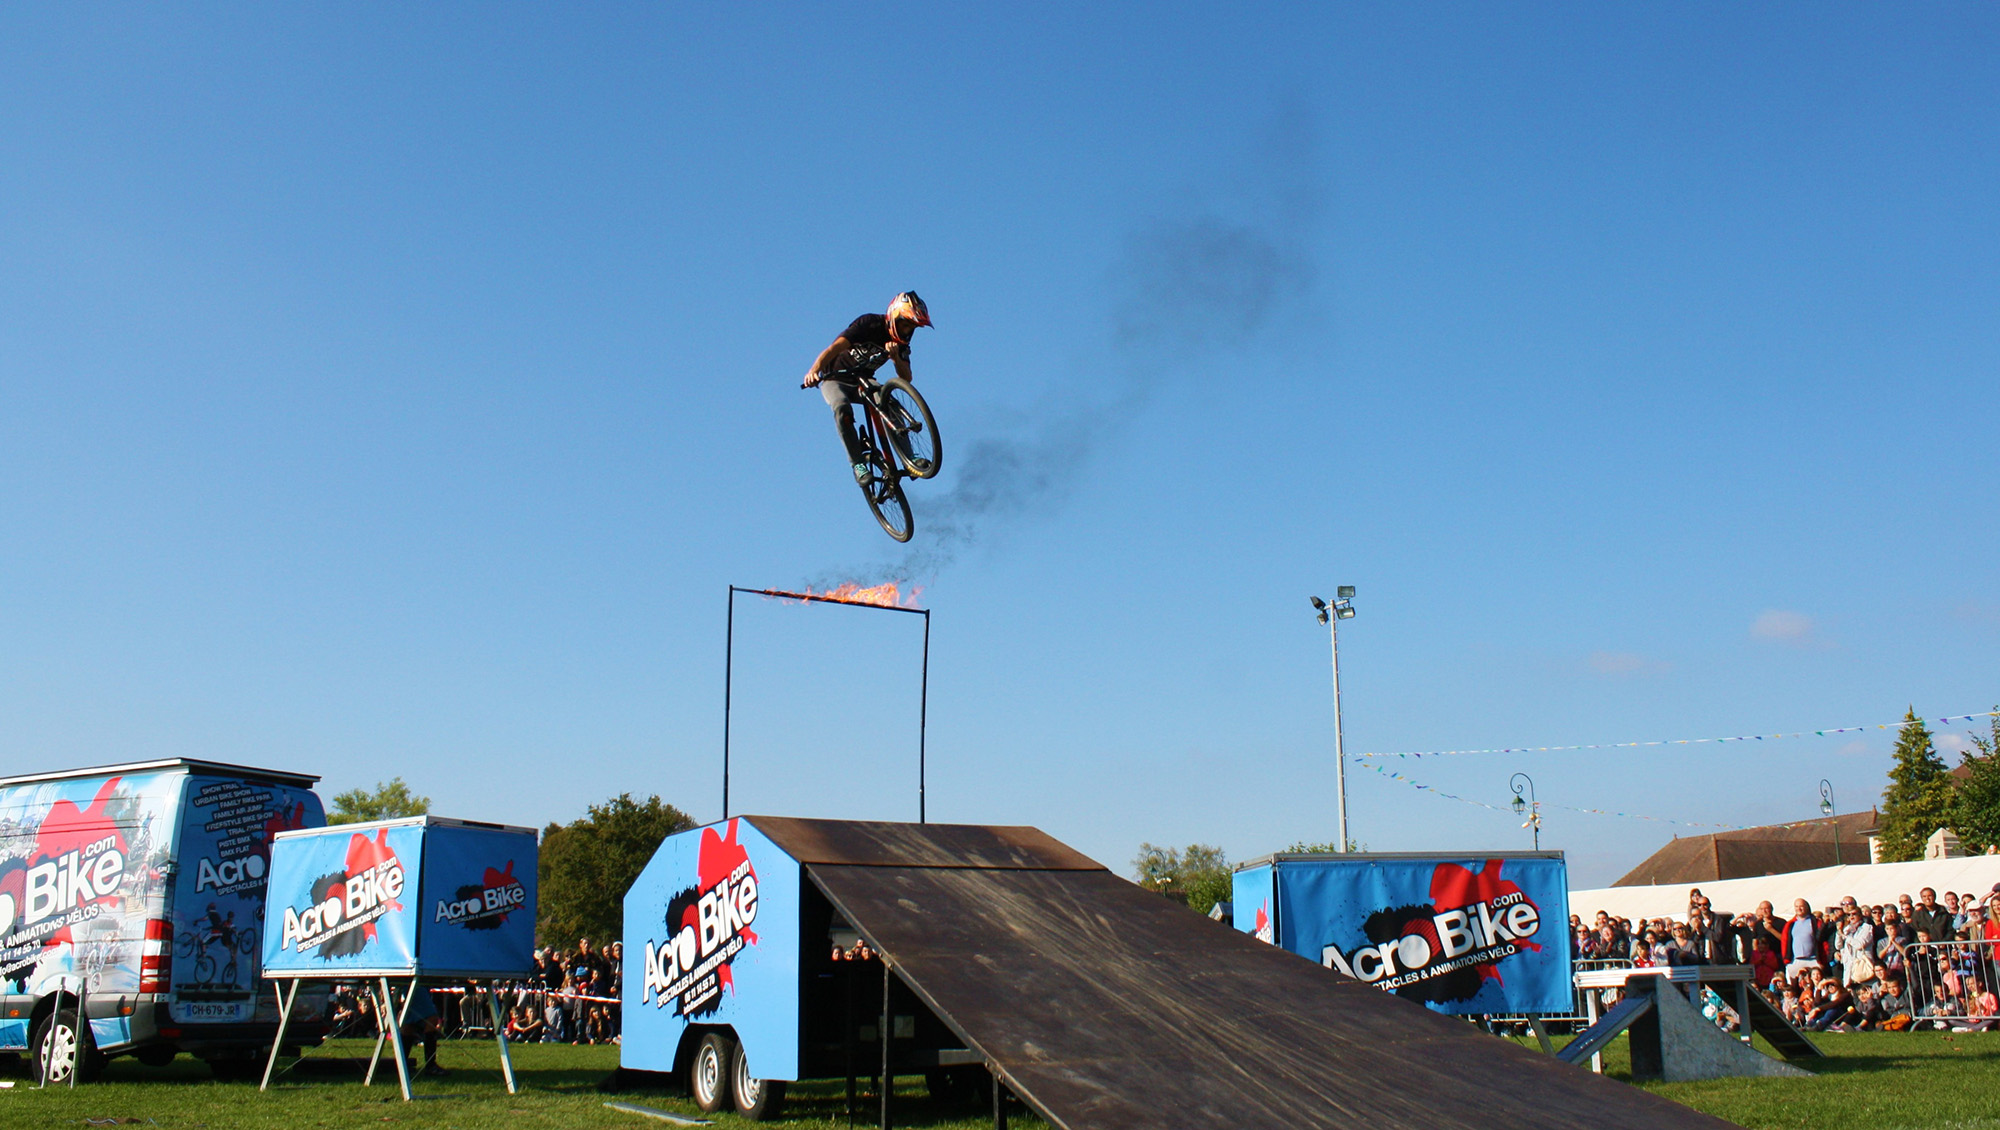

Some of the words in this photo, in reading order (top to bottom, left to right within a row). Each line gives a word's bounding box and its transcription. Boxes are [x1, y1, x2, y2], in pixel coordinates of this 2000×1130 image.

[202, 785, 222, 794] SHOW
[222, 783, 239, 791] TRIAL
[194, 795, 218, 806] URBAN
[220, 792, 233, 800] BIKE
[235, 789, 251, 797] SHOW
[220, 800, 241, 809] FAMILY
[242, 796, 255, 804] BIKE
[213, 810, 235, 819] FAMILY
[236, 808, 246, 816] AIR
[247, 805, 263, 813] JUMP
[206, 819, 242, 831] FREESTYLE
[243, 815, 256, 823] BIKE
[257, 811, 273, 820] SHOW
[228, 827, 245, 836] TRIAL
[219, 839, 237, 848] PISTE
[238, 836, 251, 844] BMX
[220, 849, 235, 857] BMX
[235, 845, 250, 853] FLAT
[217, 880, 256, 896] SPECTACLES
[6, 916, 65, 948] ANIMATIONS
[66, 903, 99, 924] VÉLOS
[297, 929, 332, 953] SPECTACLES
[336, 911, 372, 934] ANIMATIONS
[4, 951, 12, 961] 11
[13, 947, 22, 957] 14
[22, 943, 32, 954] 55
[32, 939, 41, 950] 70
[1372, 972, 1419, 991] TACLES
[1420, 970, 1429, 980] &
[1430, 952, 1488, 977] ANIMATIONS
[1488, 944, 1516, 959] VÉLO
[657, 975, 689, 1008] SPECTACLES
[693, 947, 727, 982] ANIMATIONS
